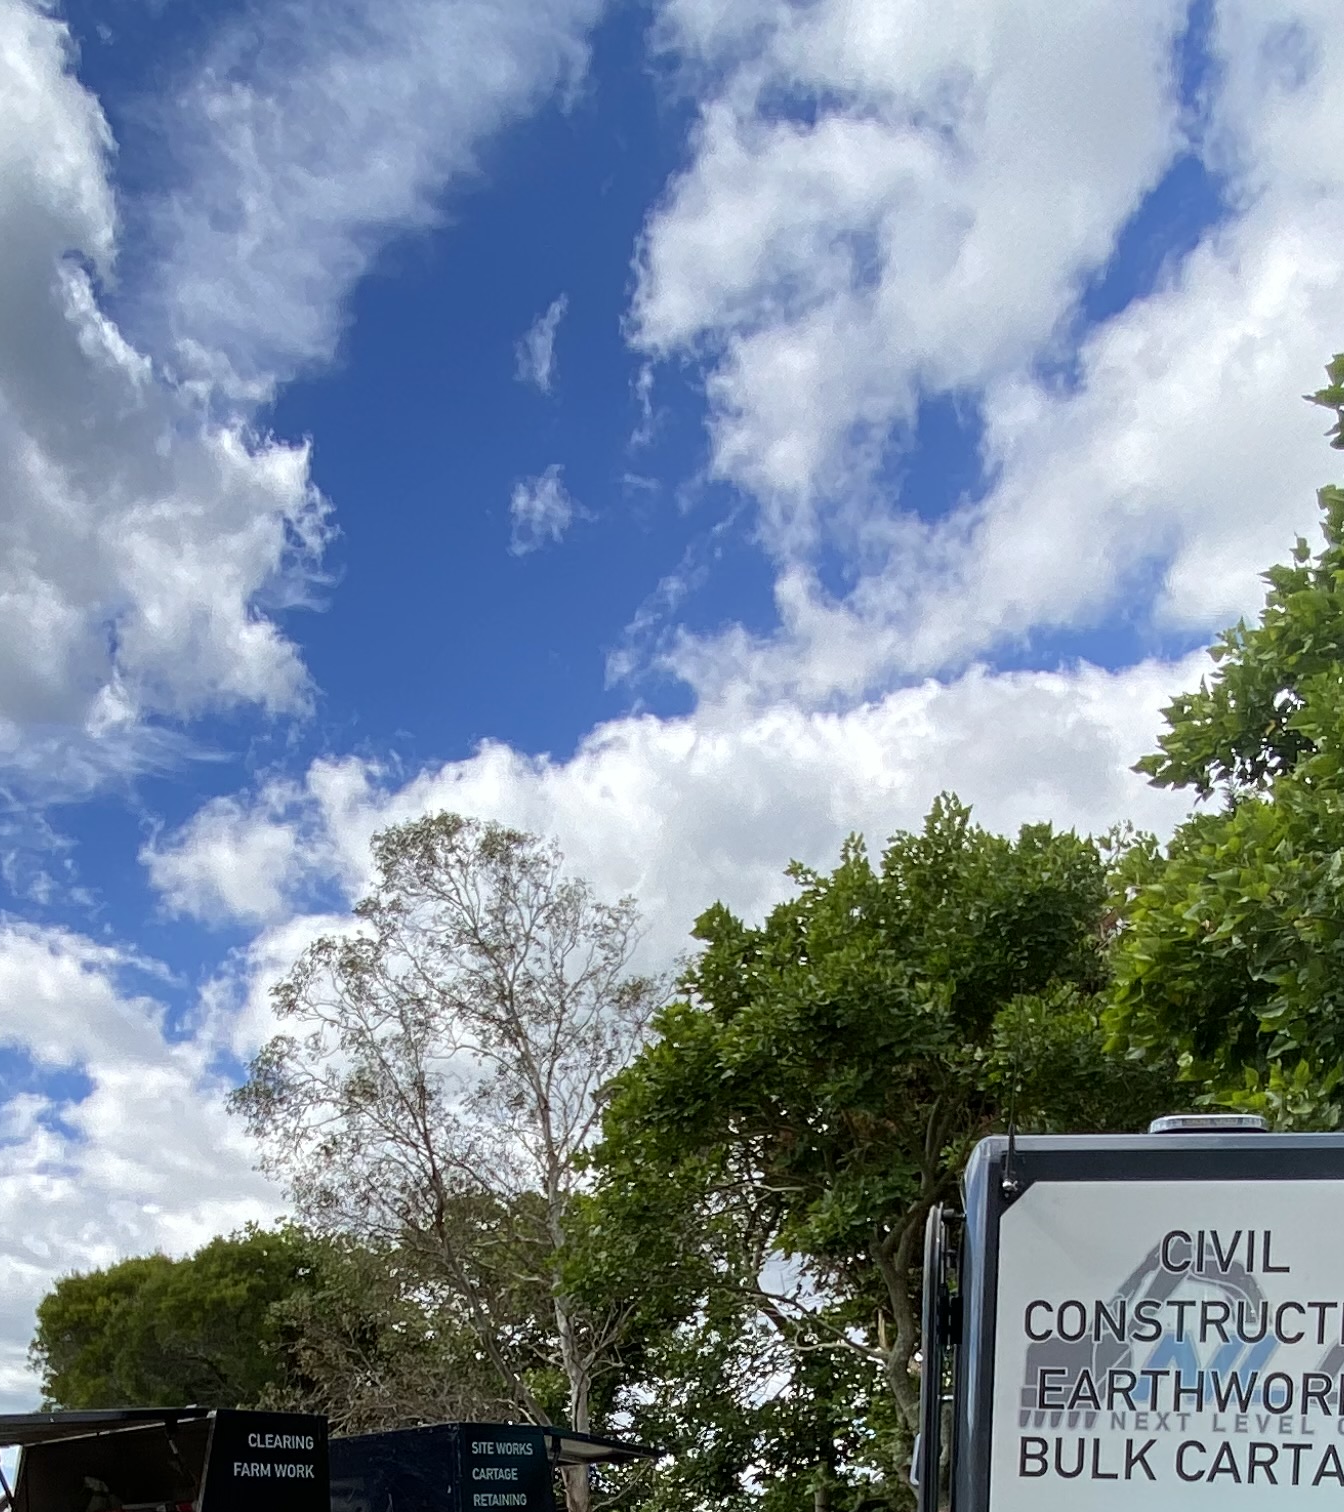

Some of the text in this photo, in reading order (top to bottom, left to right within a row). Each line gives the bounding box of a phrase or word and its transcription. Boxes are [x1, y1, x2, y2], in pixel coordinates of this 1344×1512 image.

[1160, 1229, 1291, 1274] CIVIL
[1111, 1411, 1192, 1432] NEXT
[1212, 1414, 1315, 1436] LEVEL
[248, 1433, 314, 1450] CLEARING
[471, 1441, 533, 1455] SITE WORKS
[1019, 1436, 1157, 1481] BULK
[233, 1462, 315, 1478] FARM WORK
[472, 1468, 518, 1480] CARTAGE
[473, 1493, 527, 1507] RETAINING
